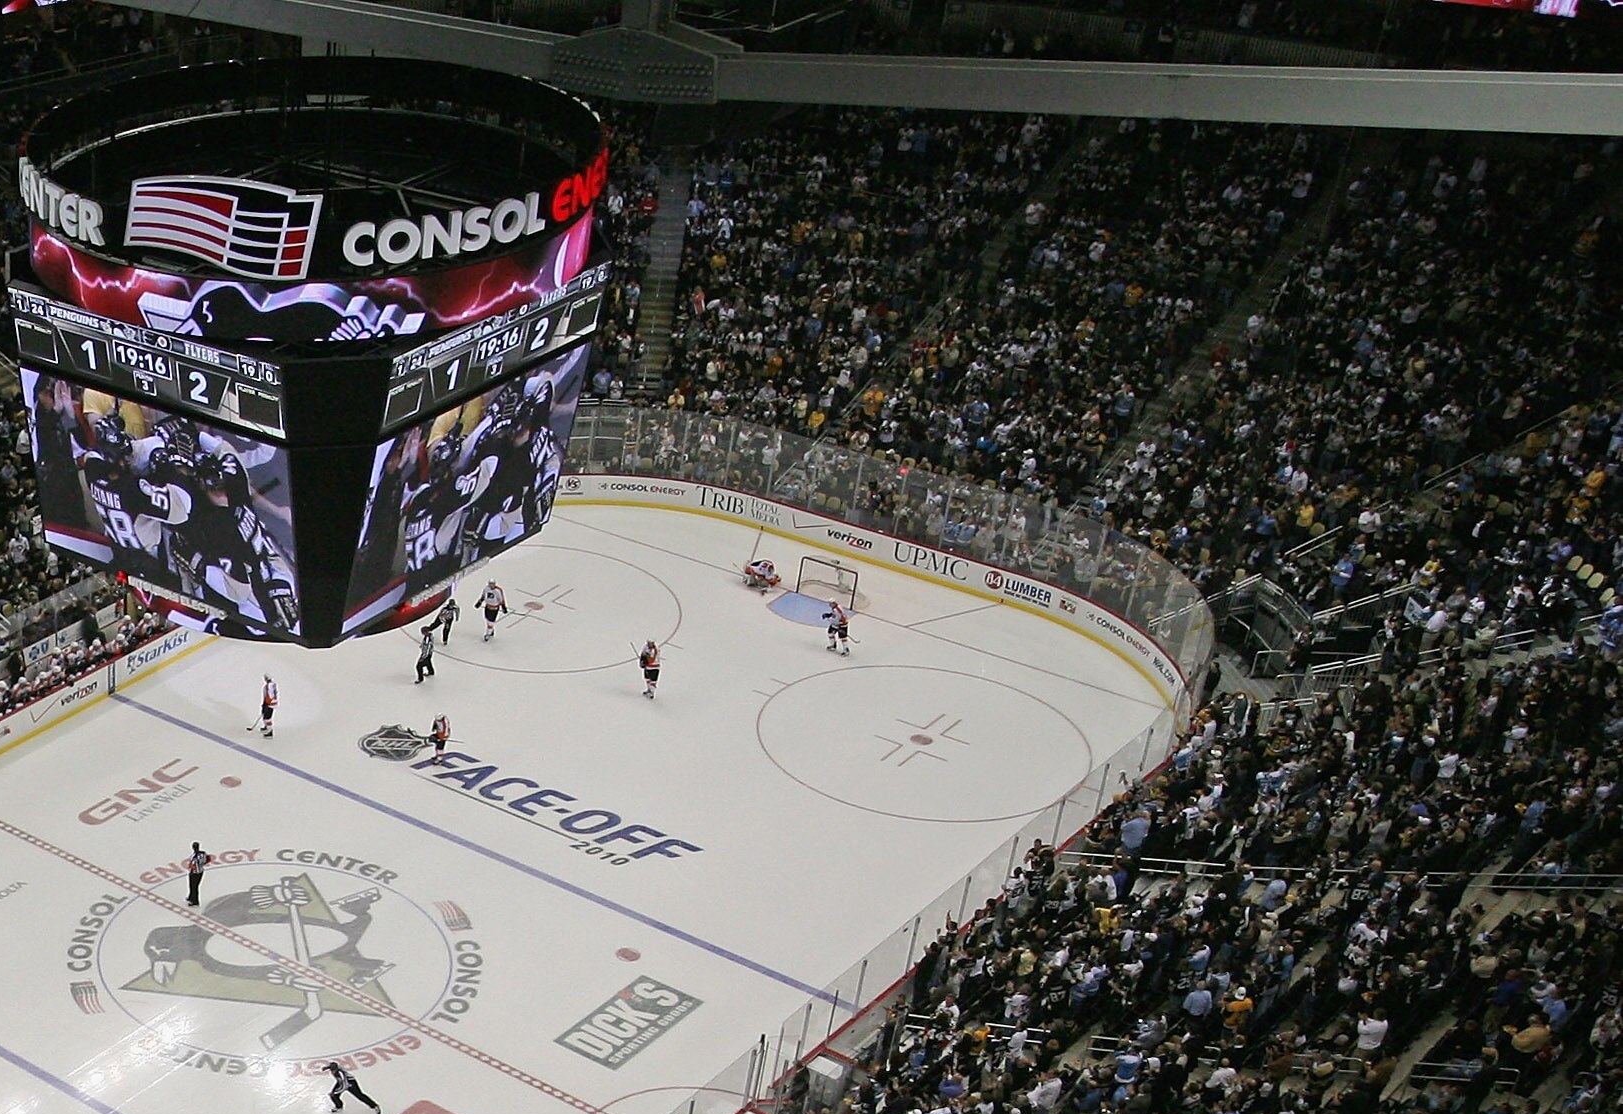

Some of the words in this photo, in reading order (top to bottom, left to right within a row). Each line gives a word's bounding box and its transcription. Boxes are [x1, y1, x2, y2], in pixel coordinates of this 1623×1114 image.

[342, 191, 546, 267] CONSOL
[31, 303, 45, 316] 24
[49, 305, 100, 329] PENGUINS
[479, 326, 520, 360] 19:16
[530, 316, 550, 351] 2
[80, 340, 97, 370] 1
[116, 345, 167, 376] 19:16
[183, 341, 221, 365] FLYERS
[241, 362, 256, 377] 19
[141, 380, 150, 391] 3
[188, 371, 210, 405] 2
[446, 358, 461, 391] 1
[610, 483, 648, 493] CONSOL
[649, 486, 687, 497] ENERGY
[695, 485, 745, 516] TRIB
[827, 526, 873, 550] verizon
[892, 541, 970, 582] UPMC
[1005, 578, 1052, 603] LUMBER
[1096, 616, 1125, 640] CONSOL
[136, 631, 190, 669] StarKist
[60, 680, 99, 706] verizon
[78, 758, 199, 826] GNC
[410, 750, 705, 862] FACE-OFF
[276, 847, 399, 886] CENTER
[569, 840, 631, 868] 2010
[66, 891, 128, 973] CONSOL
[430, 938, 484, 1025] CONSOL
[607, 1025, 660, 1065] SPORTING
